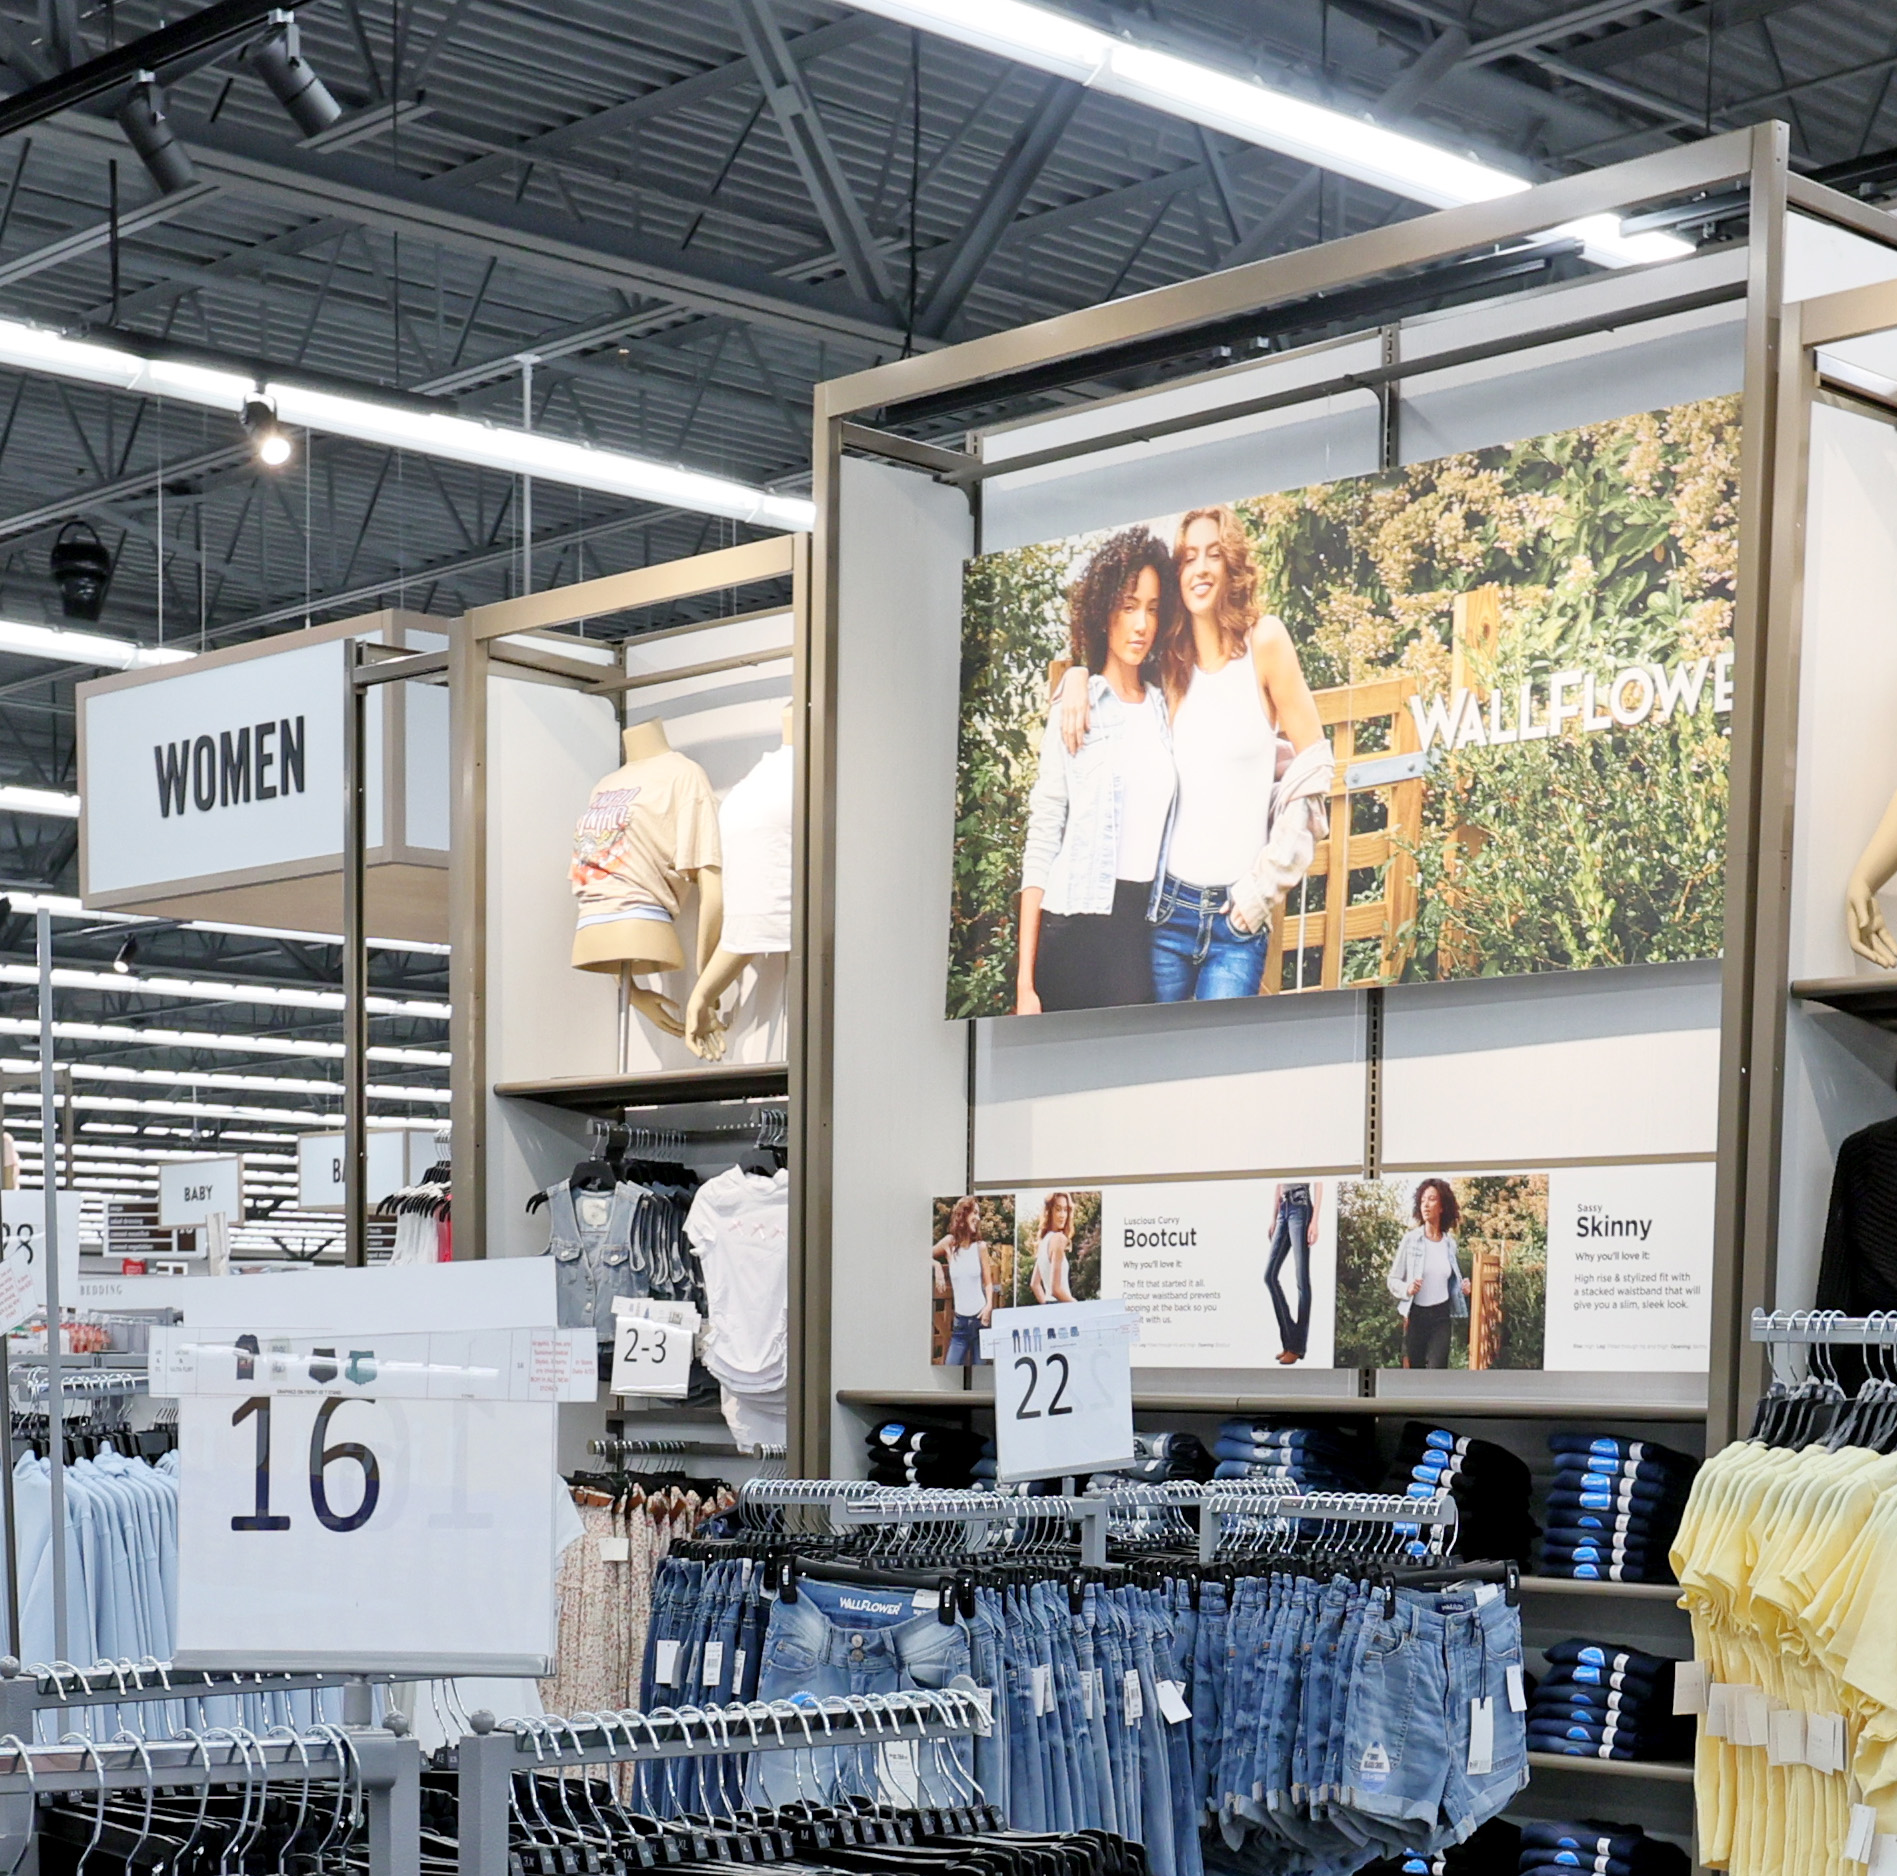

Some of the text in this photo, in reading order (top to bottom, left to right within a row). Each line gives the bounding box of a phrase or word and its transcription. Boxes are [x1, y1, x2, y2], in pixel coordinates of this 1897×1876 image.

[154, 715, 305, 818] WOMEN
[184, 1185, 213, 1201] BABY
[1577, 1203, 1602, 1213] Sassy
[1124, 1216, 1180, 1226] Luscious Curvy
[1576, 1215, 1652, 1241] Skinny
[1124, 1228, 1197, 1248] Bootcut
[1575, 1252, 1594, 1262] Why
[1622, 1252, 1640, 1261] love
[1123, 1260, 1138, 1270] Why
[1160, 1260, 1174, 1268] love
[1122, 1280, 1135, 1288] The
[1146, 1280, 1160, 1288] that
[1162, 1280, 1187, 1288] started
[1574, 1273, 1690, 1284] High rise & stylized fit with
[80, 1285, 123, 1296] BEDDING
[1122, 1291, 1221, 1301] Contour waistband prevents
[1581, 1287, 1614, 1295] stacked
[1617, 1286, 1662, 1295] waistband
[1665, 1286, 1683, 1295] that
[1685, 1286, 1701, 1295] will
[1161, 1304, 1173, 1312] the
[1174, 1304, 1191, 1312] back
[1204, 1304, 1217, 1313] you
[1573, 1301, 1591, 1311] give
[1594, 1302, 1610, 1311] you
[1642, 1300, 1664, 1309] sleek
[624, 1328, 667, 1364] 2-3
[1014, 1353, 1072, 1420] 22
[231, 1396, 380, 1532] 16
[840, 1597, 900, 1615] WALLFLOWER
